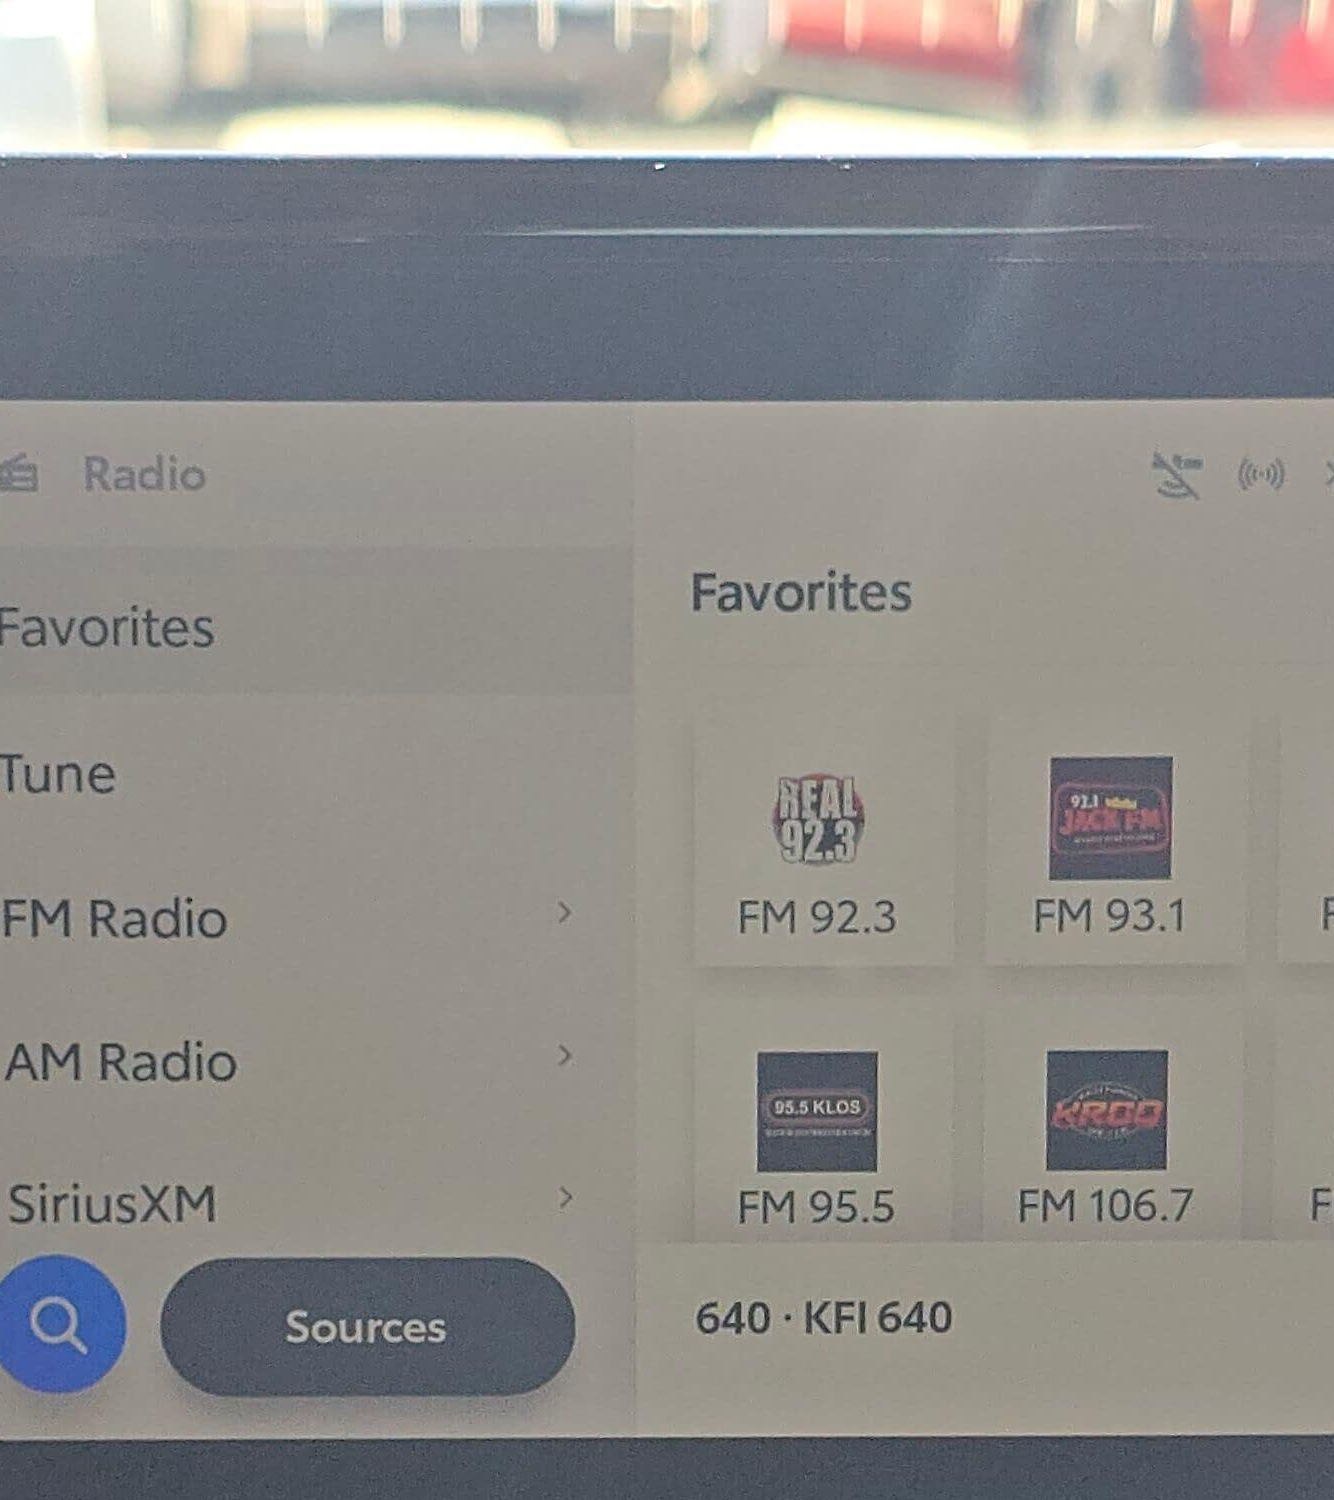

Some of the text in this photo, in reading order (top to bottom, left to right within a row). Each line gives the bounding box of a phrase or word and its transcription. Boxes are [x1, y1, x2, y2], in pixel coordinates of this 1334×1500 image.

[85, 454, 206, 492] Radio
[692, 569, 912, 613] Favorites
[779, 778, 856, 819] REAL
[782, 820, 855, 861] 92.3
[3, 896, 227, 939] FM Radio
[739, 899, 896, 934] FM 92.3
[1035, 898, 1183, 933] FM 93.1
[4, 1039, 237, 1082] AM Radio
[812, 1099, 861, 1115] KLOS
[9, 1182, 215, 1224] SiriusXM
[739, 1189, 895, 1224] FM 95.5
[1019, 1188, 1194, 1223] FM 106.7
[286, 1309, 447, 1344] Sources
[696, 1301, 771, 1335] 640
[805, 1300, 866, 1335] KFI
[878, 1300, 952, 1334] 640
